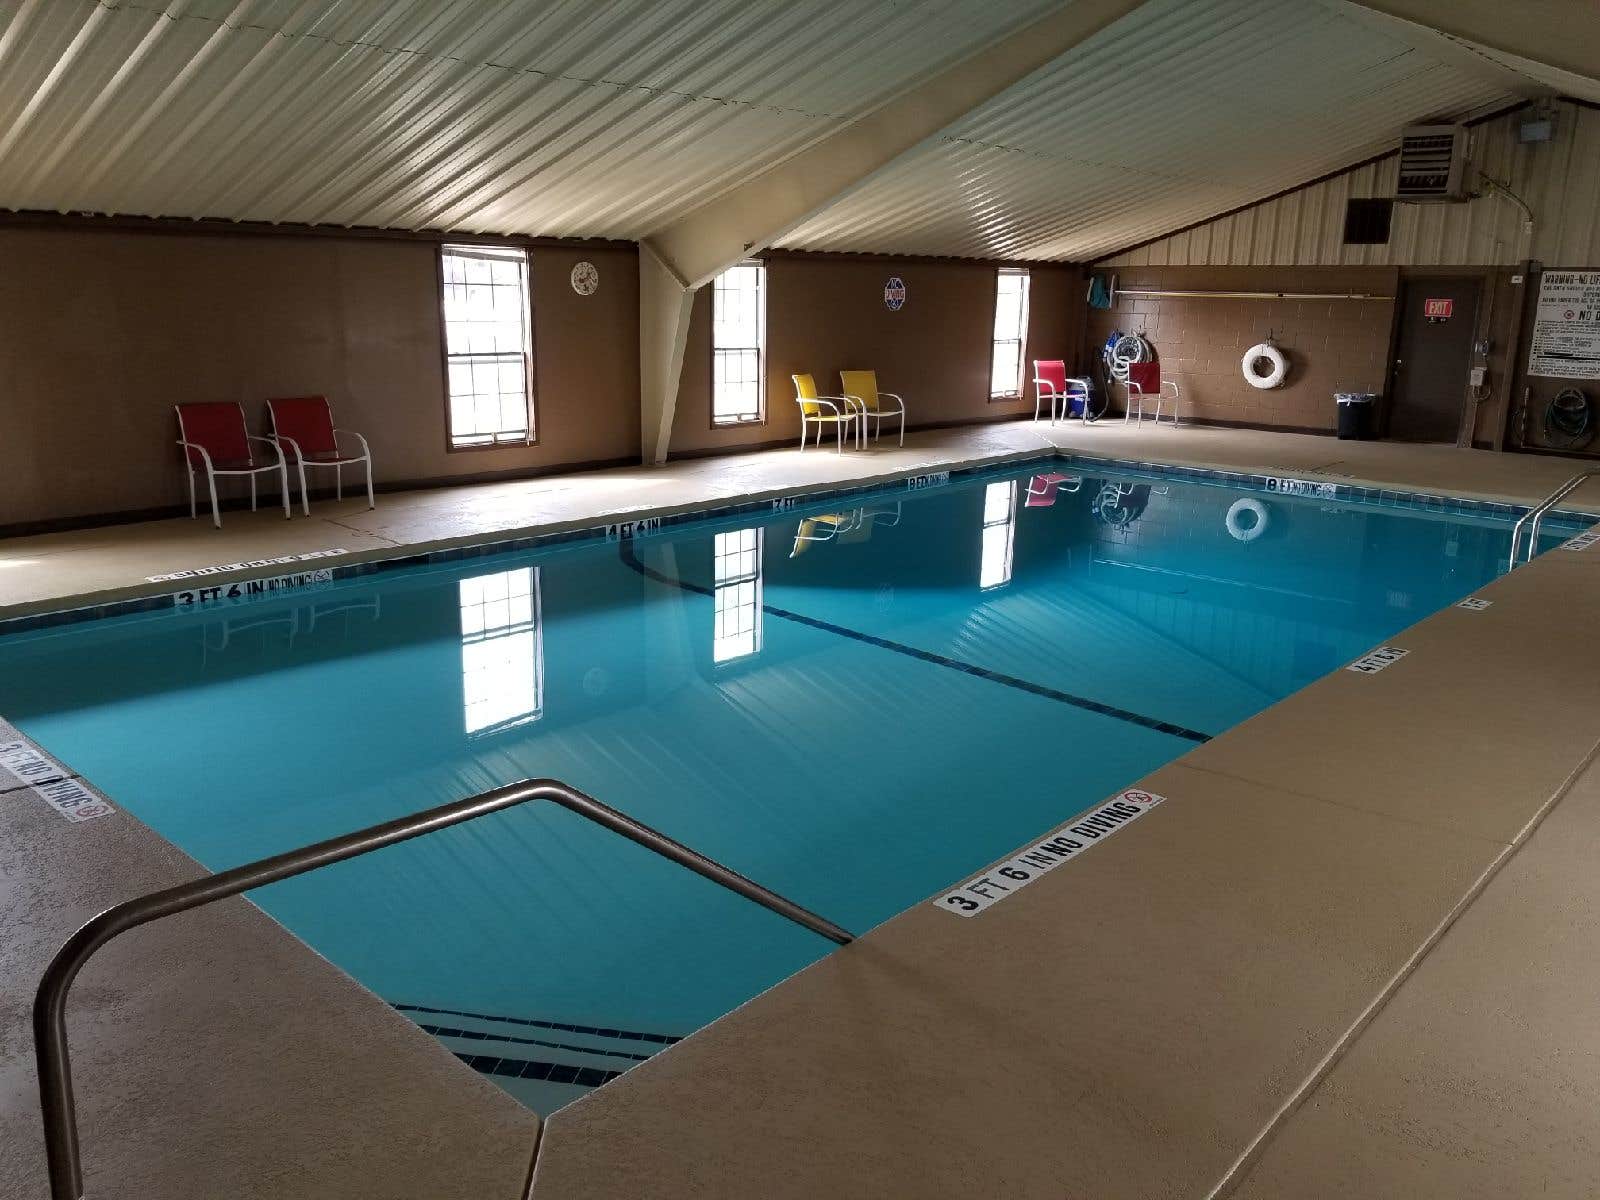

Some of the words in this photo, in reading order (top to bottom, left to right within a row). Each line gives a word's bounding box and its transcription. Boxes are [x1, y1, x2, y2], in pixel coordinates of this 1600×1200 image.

[1429, 301, 1449, 315] EXIT
[1579, 311, 1592, 320] NO
[199, 587, 221, 603] FT
[226, 584, 242, 598] 6
[247, 580, 264, 594] IN
[281, 574, 313, 590] DIVING
[947, 895, 979, 911] 3
[966, 877, 1010, 900] FT
[998, 866, 1030, 881] 6
[1018, 851, 1058, 870] IN
[1040, 837, 1084, 857] NO
[1070, 802, 1142, 839] DIVING
